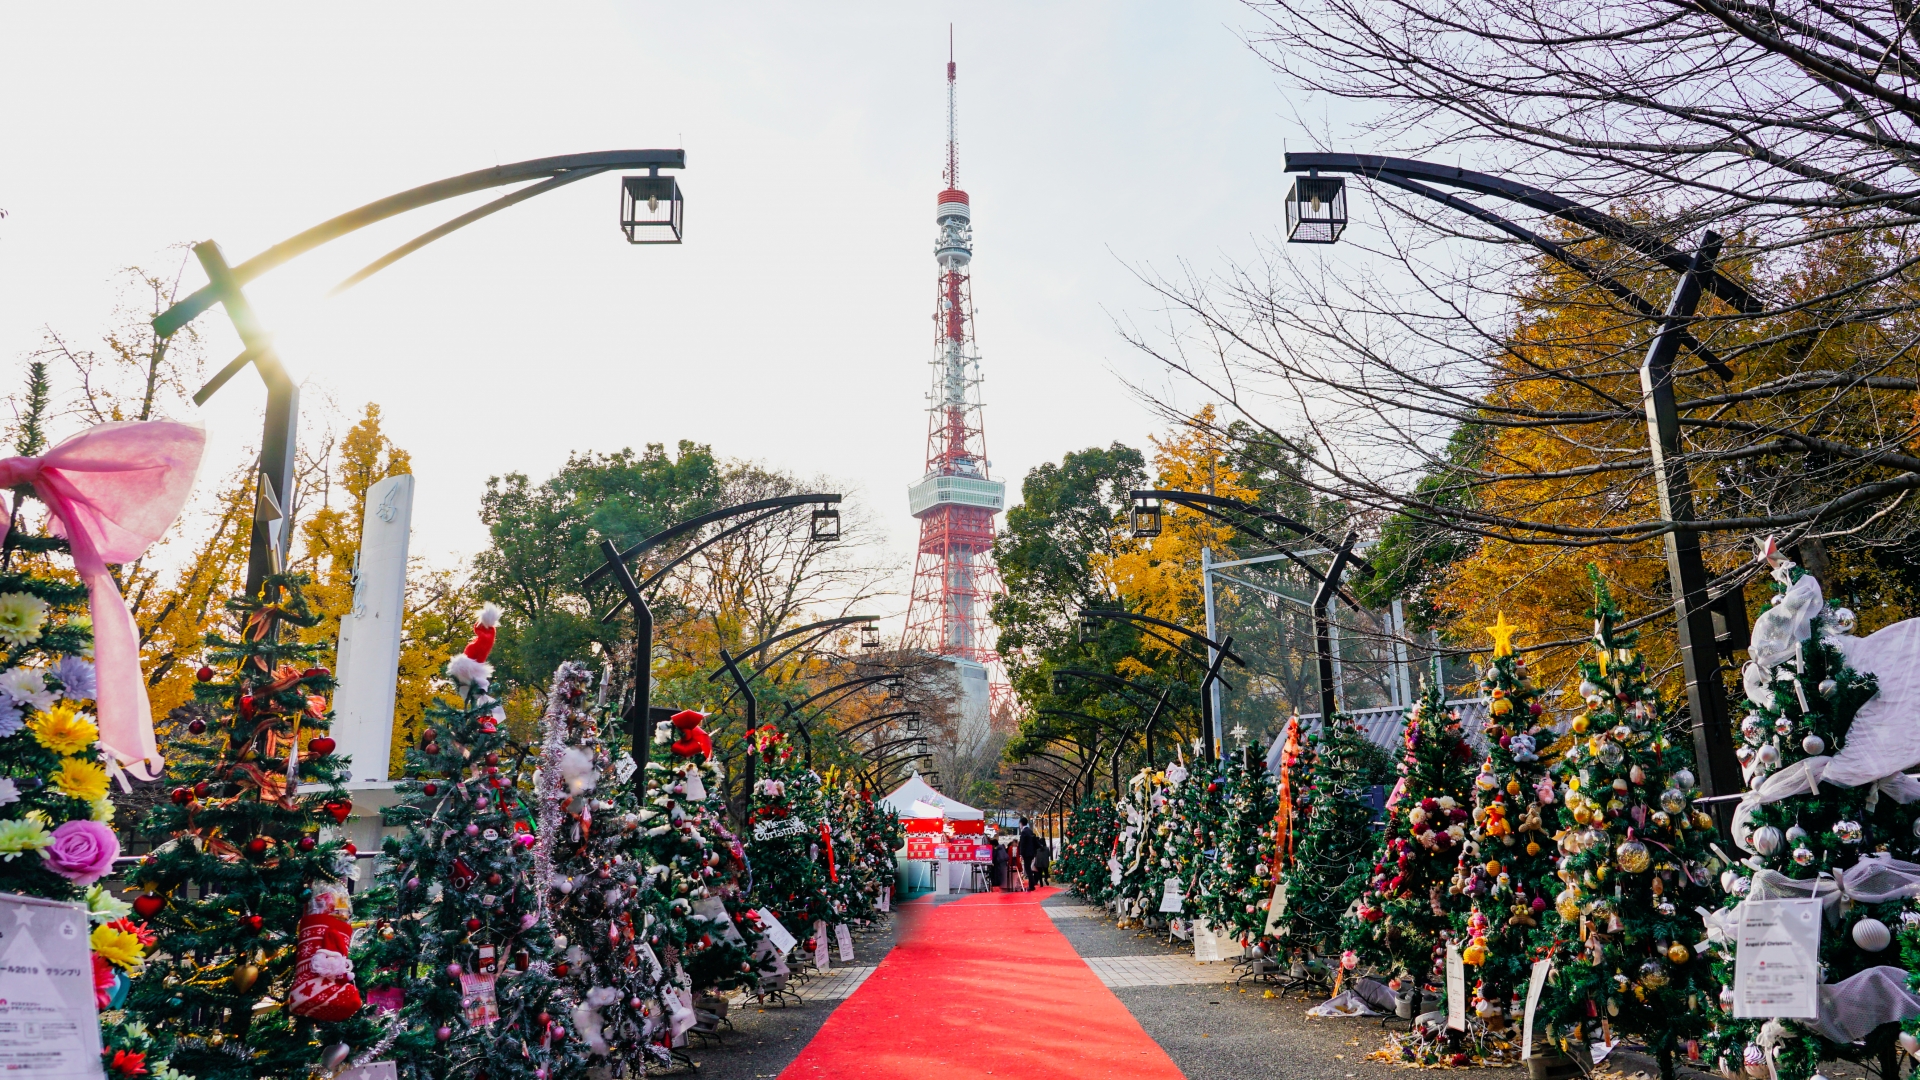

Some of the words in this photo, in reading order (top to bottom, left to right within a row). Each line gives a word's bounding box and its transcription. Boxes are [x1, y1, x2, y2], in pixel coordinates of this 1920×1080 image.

[754, 825, 808, 842] Christmas
[46, 967, 81, 977] グランプリ
